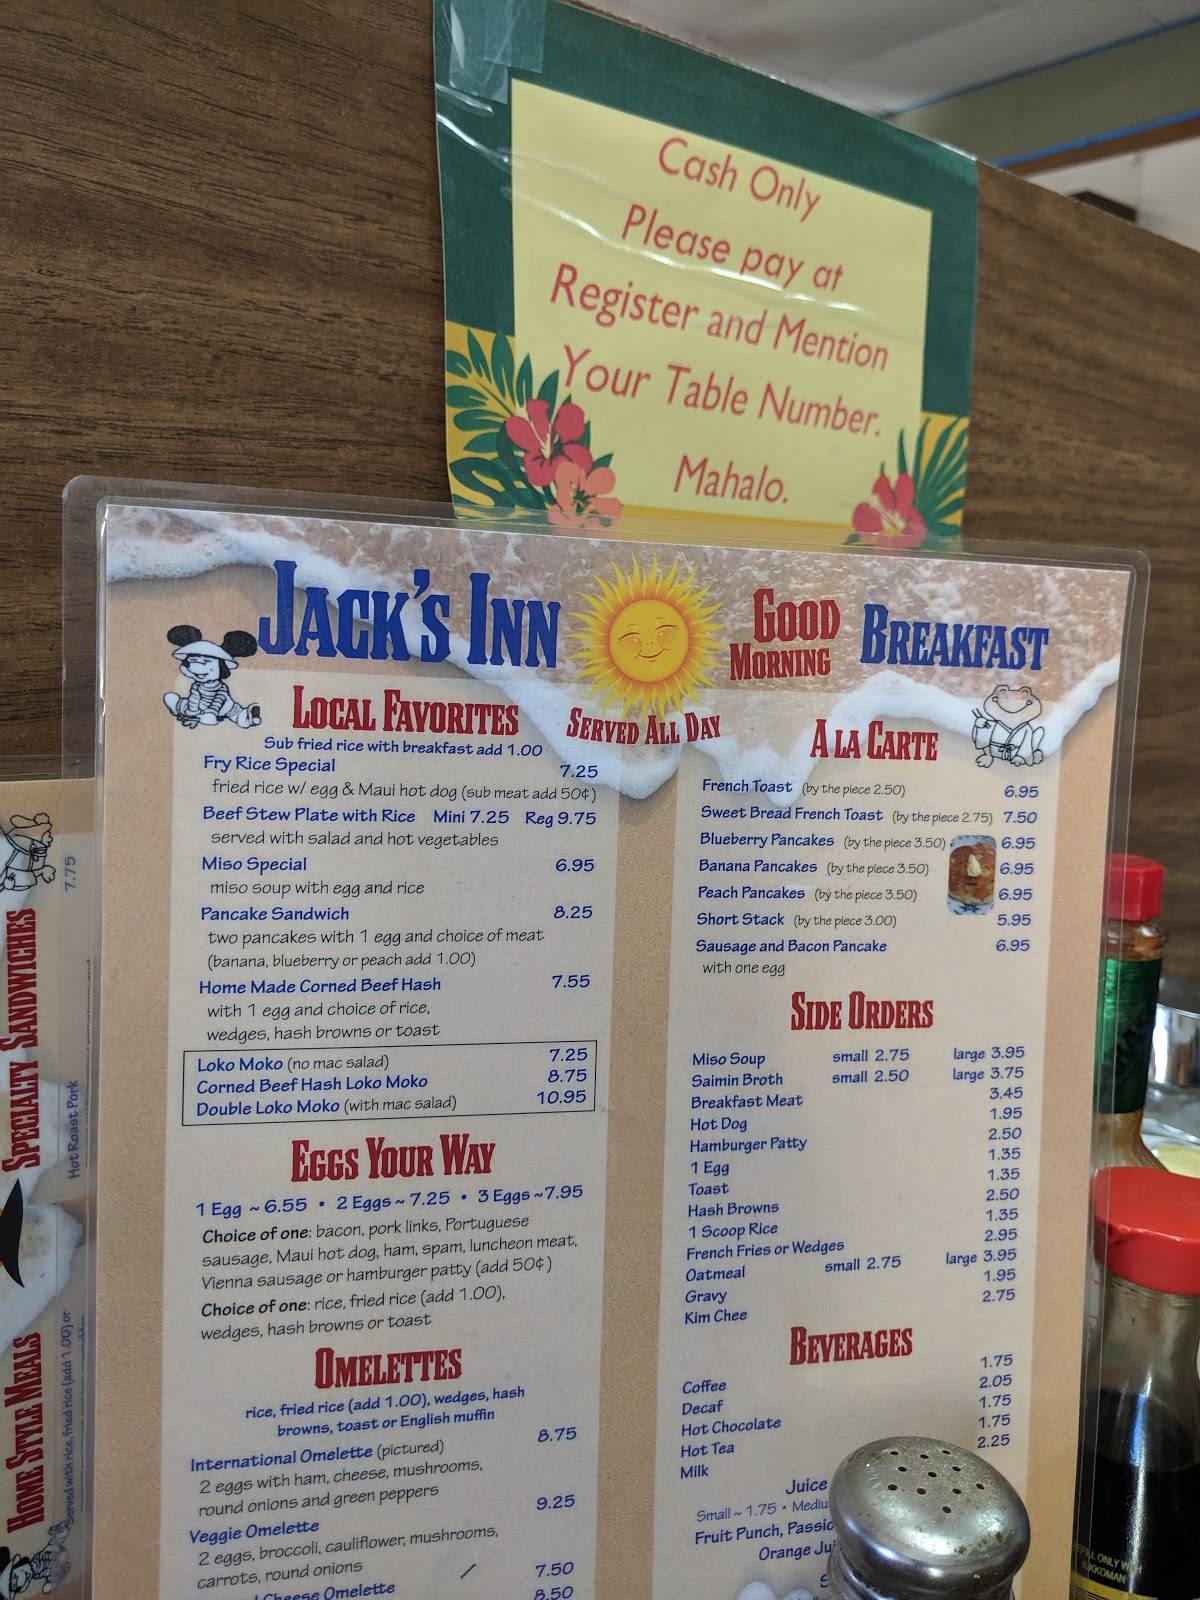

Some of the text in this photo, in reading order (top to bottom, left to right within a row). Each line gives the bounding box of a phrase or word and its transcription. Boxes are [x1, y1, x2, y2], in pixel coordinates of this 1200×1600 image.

[658, 137, 821, 223] Cash Only
[621, 203, 843, 292] Please pay at
[550, 263, 889, 371] Register and Mention
[563, 345, 881, 437] Your Table Number.
[674, 454, 789, 504] Mahalo.
[752, 588, 841, 643] GOOD
[859, 603, 1049, 671] BREAKFAST
[729, 643, 831, 680] MORNING
[292, 685, 519, 736] LOCAL FAVORITES
[566, 707, 721, 745] SERVED ALL DAY
[264, 737, 542, 756] Sub fried rice with breakfast add 1.00
[204, 756, 335, 776] Fry Rice Special
[560, 764, 597, 778] 7.25
[703, 778, 792, 792] French Toast
[802, 782, 905, 798] (by the piece 2.50)
[1004, 785, 1038, 798] 6.95
[203, 806, 415, 822] Beef Stew Plate with Rice
[434, 810, 509, 823] Mini 7.25
[525, 811, 596, 828] Reg 9.75
[211, 831, 498, 849] served with salad and hot vegetables
[700, 832, 834, 848] Blueberry Pancakes
[844, 836, 945, 850] (by the piece 3.50)
[1001, 837, 1035, 849] 6.95
[64, 856, 77, 891] 7.75
[202, 857, 306, 875] Miso Special
[555, 859, 594, 871] 6.95
[201, 906, 348, 920] Pancake Sandwich
[553, 906, 592, 918] 8.25
[791, 991, 933, 1030] SIDE ORDERS
[0, 908, 40, 1171] SPECIALTY SANDWICHES
[549, 1048, 587, 1061] 7.25
[693, 1052, 765, 1069] Miso Soup
[832, 1048, 909, 1062] small 2.75
[953, 1046, 1024, 1062] large 3.95
[198, 1054, 388, 1073] Loko Moko (no mac salad)
[197, 1075, 427, 1094] Corned Beef Hash Loko Moko
[547, 1069, 586, 1083] 8.75
[990, 1086, 1023, 1099] 3.45
[691, 1094, 803, 1109] Breakfast Meat
[66, 1080, 80, 1179] Hot Roast Pork
[291, 1133, 495, 1182] EGGS YOUR WAY
[203, 1217, 528, 1243] Choice of one: bacon, pork links, Portuguese
[825, 1255, 900, 1272] small 2.75
[946, 1248, 1016, 1267] large 3.95
[685, 1265, 744, 1281] Oatmeal
[685, 1309, 747, 1324] Kim Chee
[789, 1327, 912, 1365] BEVERAGES
[314, 1347, 462, 1389] OMELETTES
[981, 1353, 1013, 1368] 1.75
[682, 1379, 726, 1394] Coffee
[4, 1332, 45, 1533] HOME STYLE MEALS
[537, 1427, 576, 1442] 8.75
[191, 1440, 443, 1471] International Omelette (pictured)
[200, 1460, 482, 1495] 2 eggs with ham, cheese, mushrooms,
[680, 1464, 708, 1478] Milk
[785, 1479, 827, 1494] Juice
[536, 1494, 575, 1510] 9.25
[189, 1521, 319, 1545] Veggie Omelette
